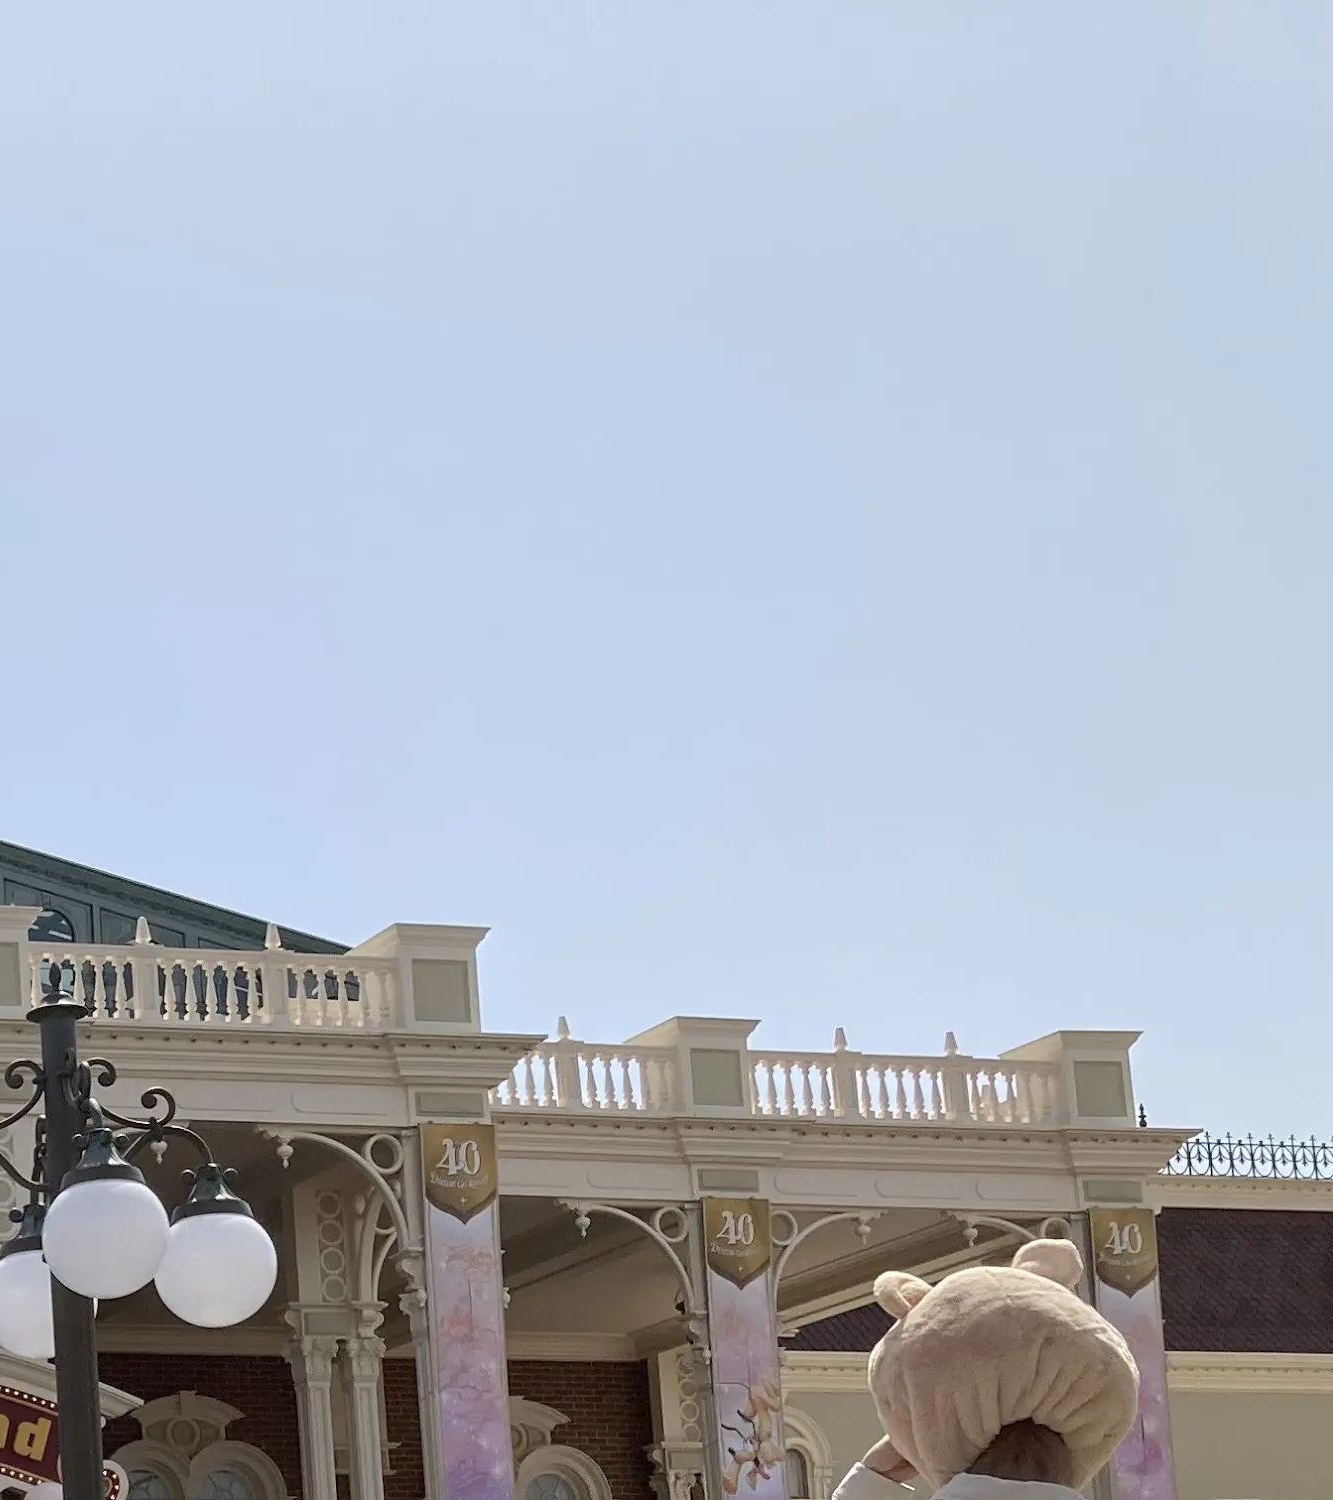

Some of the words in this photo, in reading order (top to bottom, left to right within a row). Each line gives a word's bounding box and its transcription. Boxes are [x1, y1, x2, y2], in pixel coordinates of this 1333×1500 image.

[435, 1138, 481, 1175] 40
[715, 1210, 755, 1245] 40
[1104, 1221, 1143, 1255] 40
